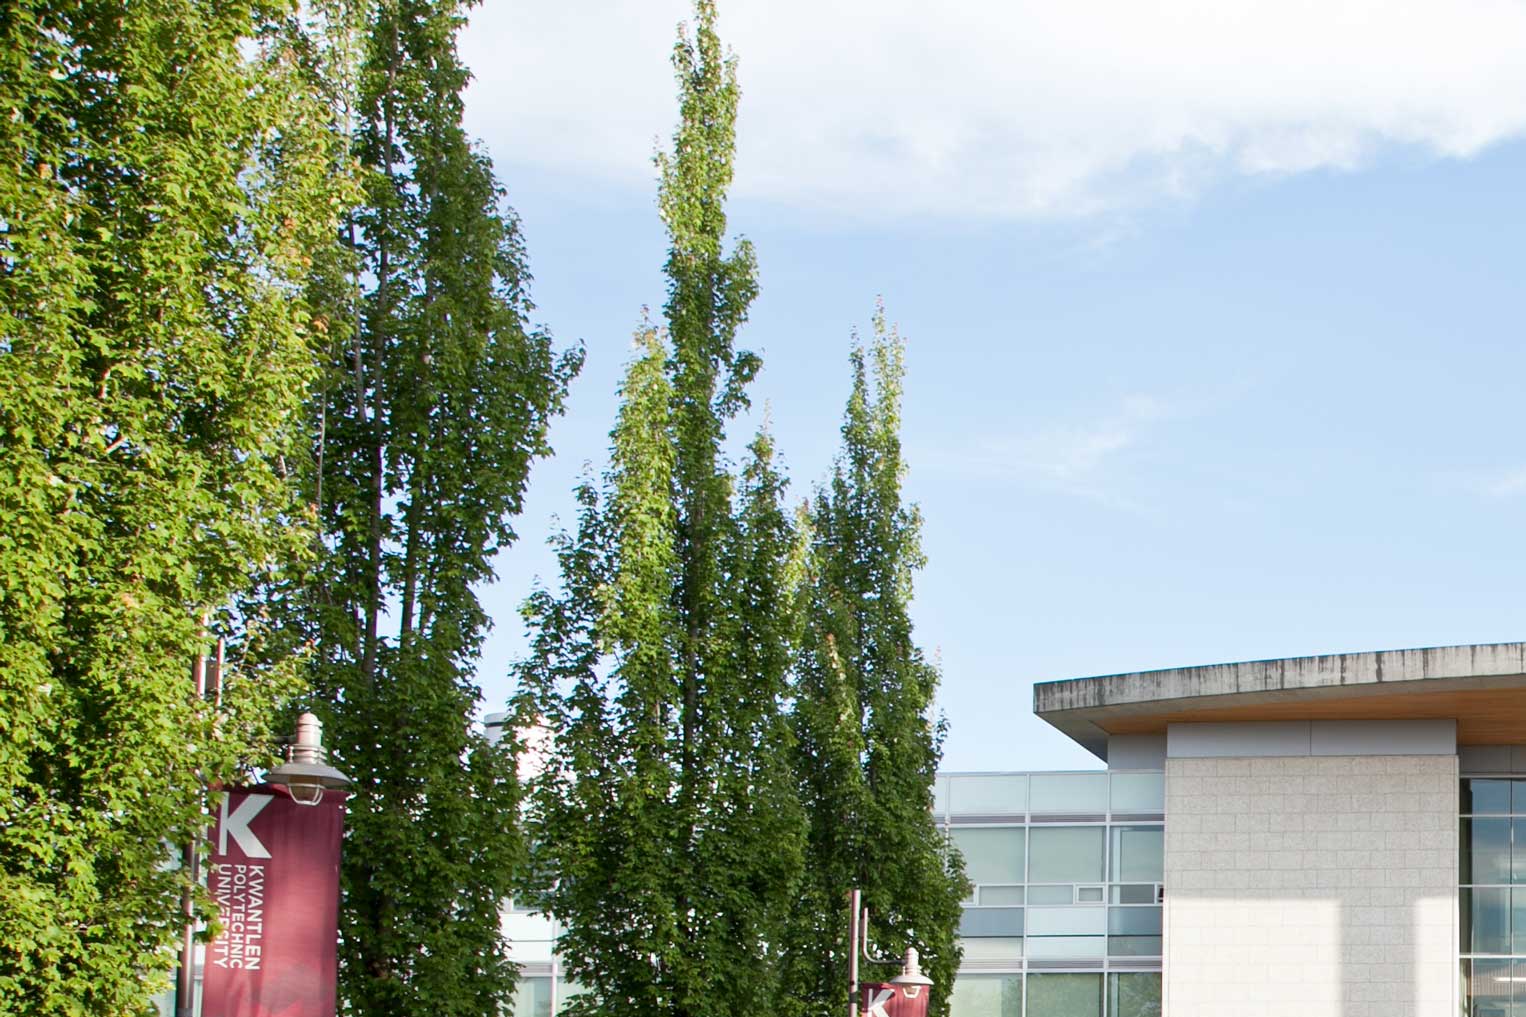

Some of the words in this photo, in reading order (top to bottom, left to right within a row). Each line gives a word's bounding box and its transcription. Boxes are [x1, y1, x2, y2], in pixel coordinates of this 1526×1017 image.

[218, 791, 274, 859] K
[229, 864, 247, 969] POLYTECHNIC
[244, 865, 265, 970] KWANTLEN
